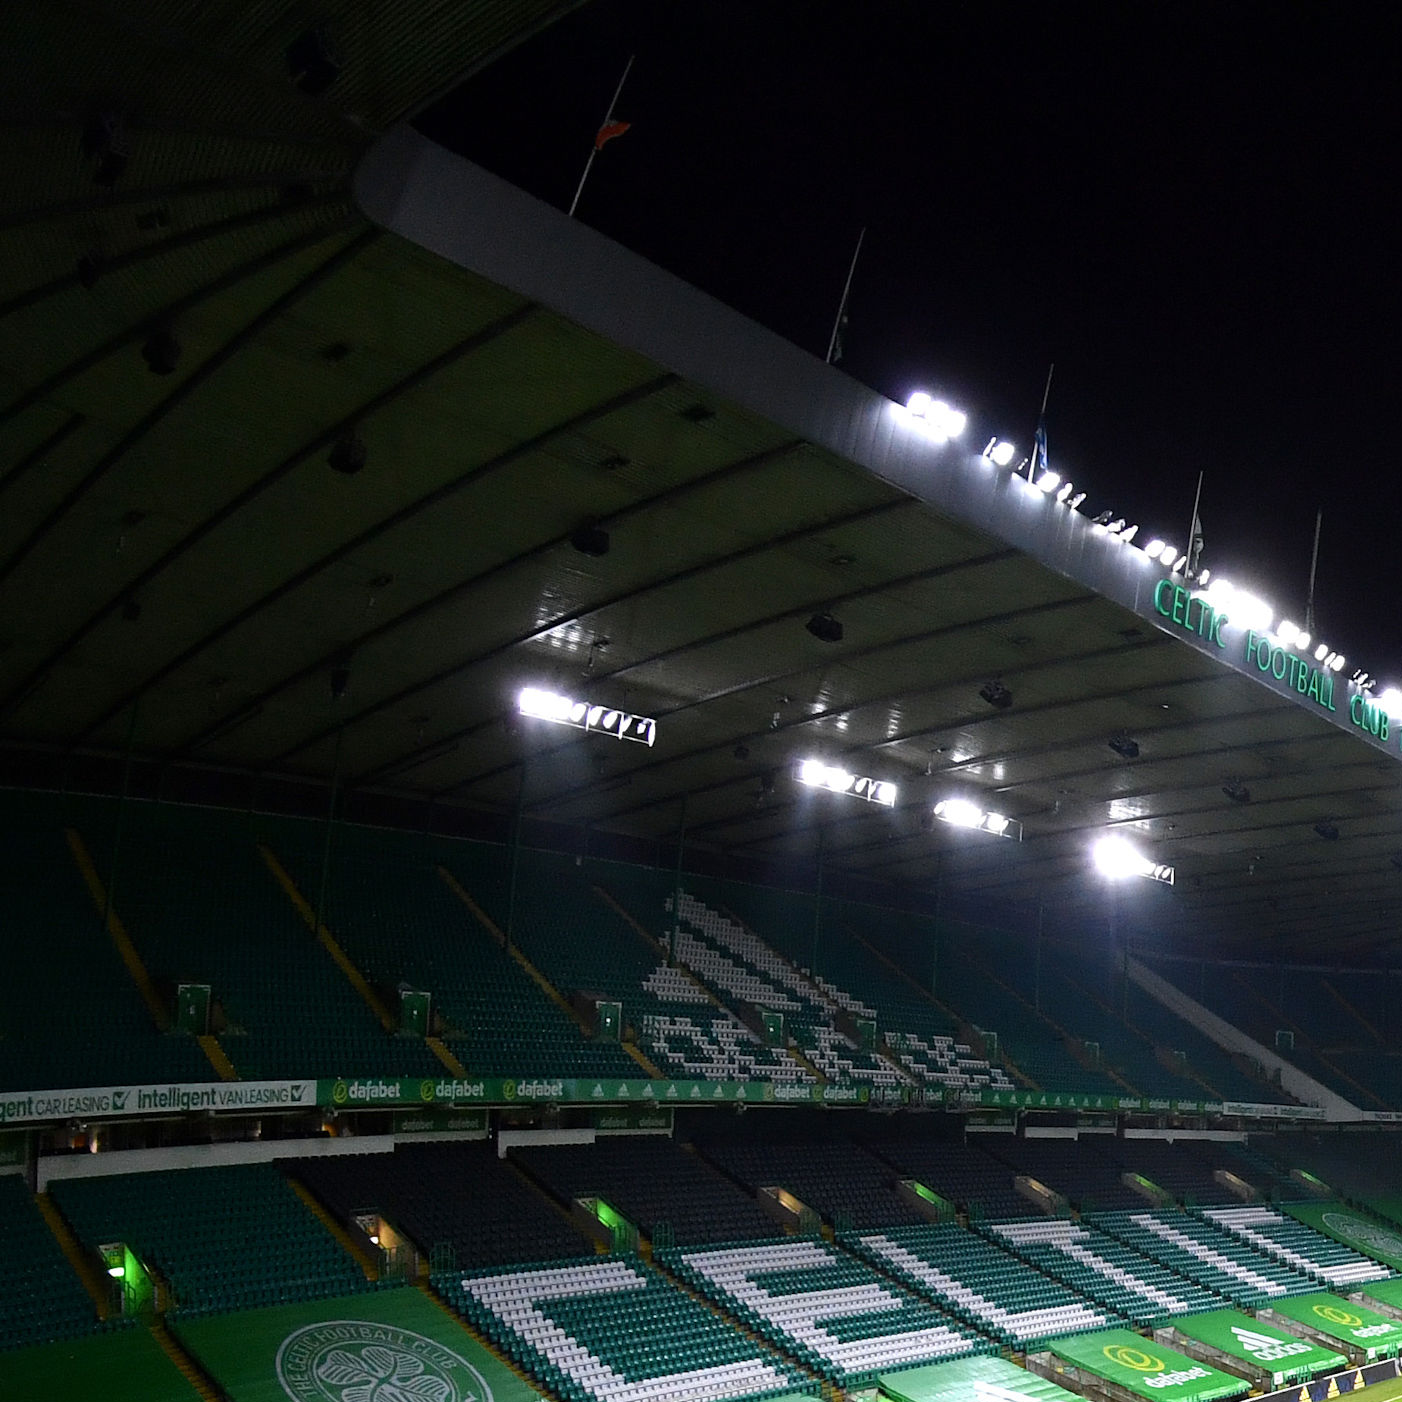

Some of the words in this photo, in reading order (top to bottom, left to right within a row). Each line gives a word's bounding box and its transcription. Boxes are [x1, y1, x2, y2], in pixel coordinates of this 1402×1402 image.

[1154, 577, 1229, 648] CELTIC
[1245, 628, 1337, 712] FOOTBALL
[1350, 693, 1390, 743] CLUB
[138, 1087, 216, 1110] intelligent
[348, 1080, 400, 1100] dafabet
[435, 1080, 484, 1099] dafabet
[517, 1080, 563, 1099] dafabet
[774, 1084, 810, 1099] dafabet
[824, 1085, 858, 1100] dafabet
[315, 1327, 406, 1349] FOOTBALL
[1352, 1322, 1400, 1339] dafabet
[286, 1336, 320, 1372] CELTIC
[412, 1340, 457, 1371] CLUB
[1253, 1340, 1313, 1361] adidas
[288, 1375, 313, 1398] THE
[1143, 1366, 1212, 1389] dafabet
